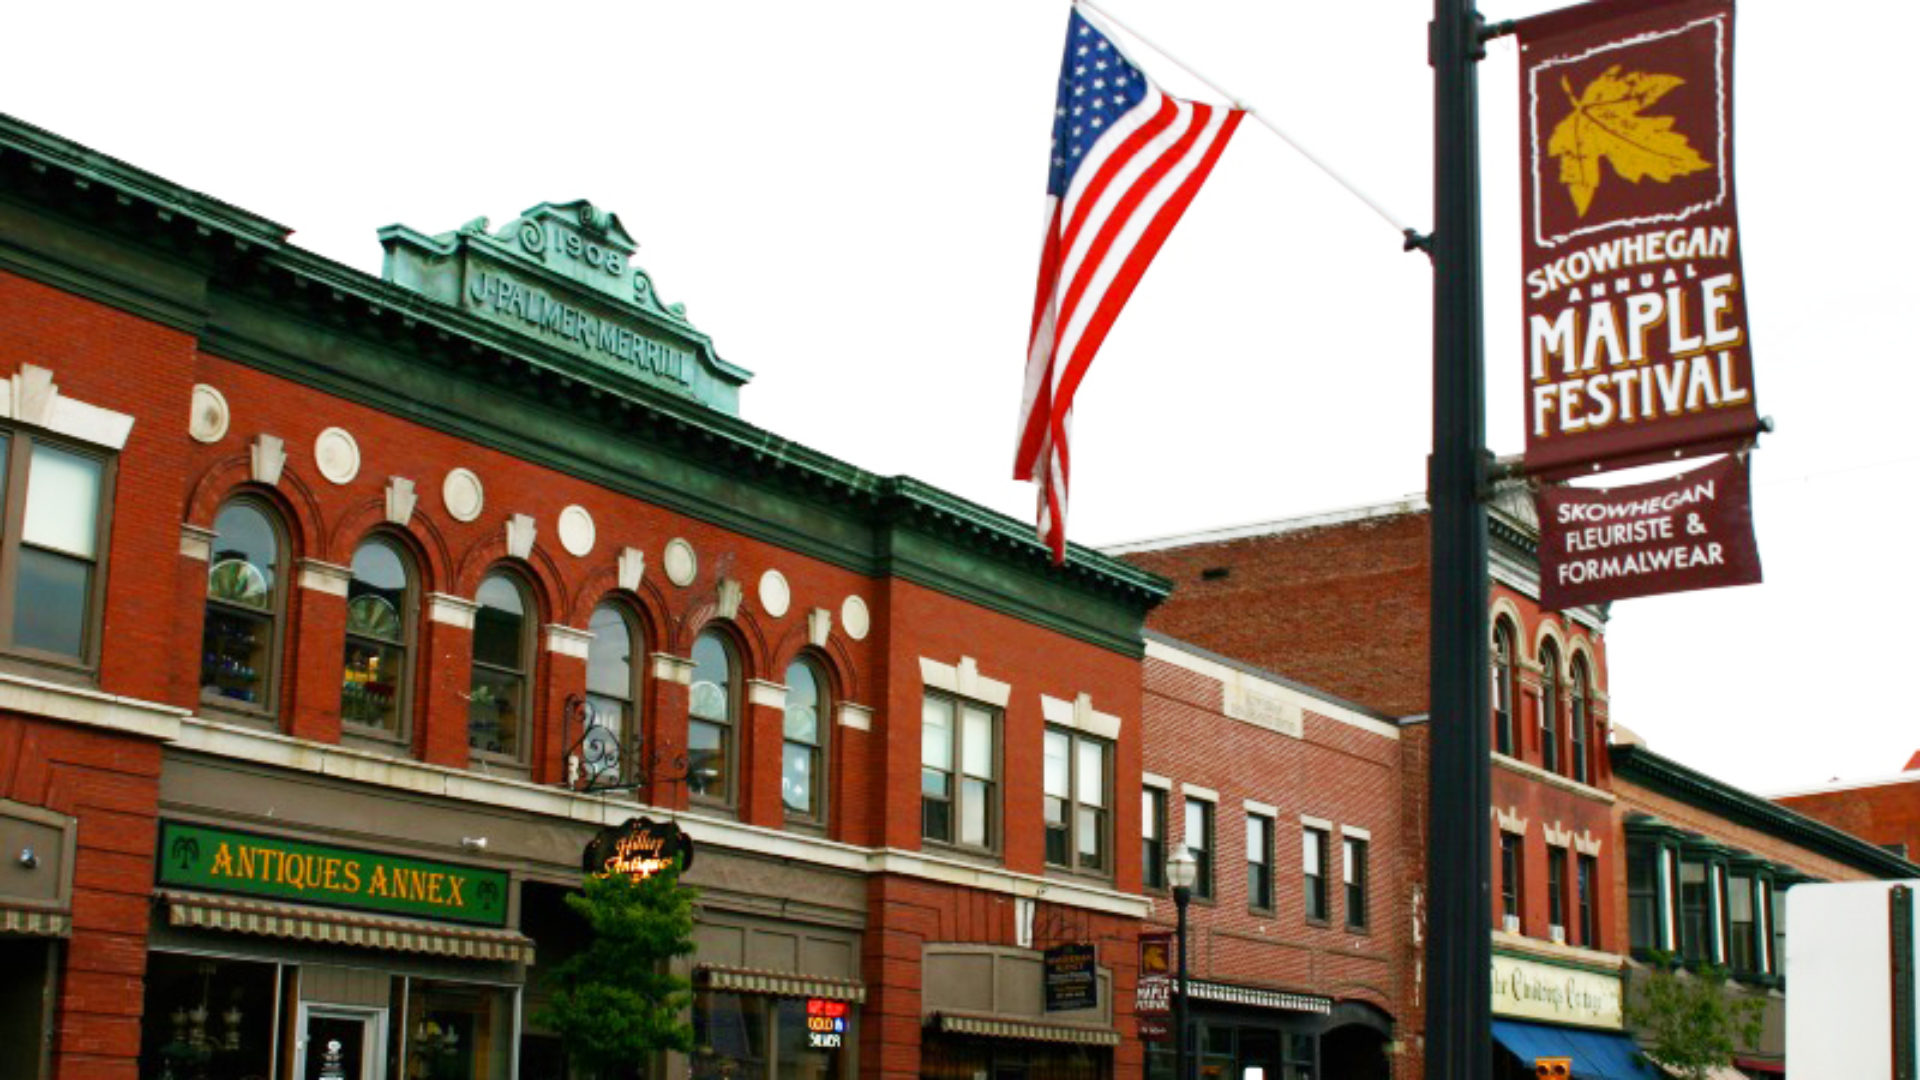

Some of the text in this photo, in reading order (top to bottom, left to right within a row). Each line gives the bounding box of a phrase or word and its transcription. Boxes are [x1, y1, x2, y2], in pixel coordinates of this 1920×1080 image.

[553, 225, 624, 277] 1908
[1526, 226, 1732, 299] SKOWHEGAN
[1568, 263, 1698, 303] ANNUAL
[1529, 273, 1743, 383] MAPLE
[1533, 350, 1750, 437] FESTIVAL
[1557, 479, 1716, 524] SKOWHEGAN
[1566, 512, 1708, 553] FLEURISTE &
[1557, 542, 1725, 586] FORMALWEAR
[210, 841, 467, 907] ANTIQUES ANNEX
[1137, 986, 1169, 1000] MAPLE
[808, 1016, 834, 1032] GOLD
